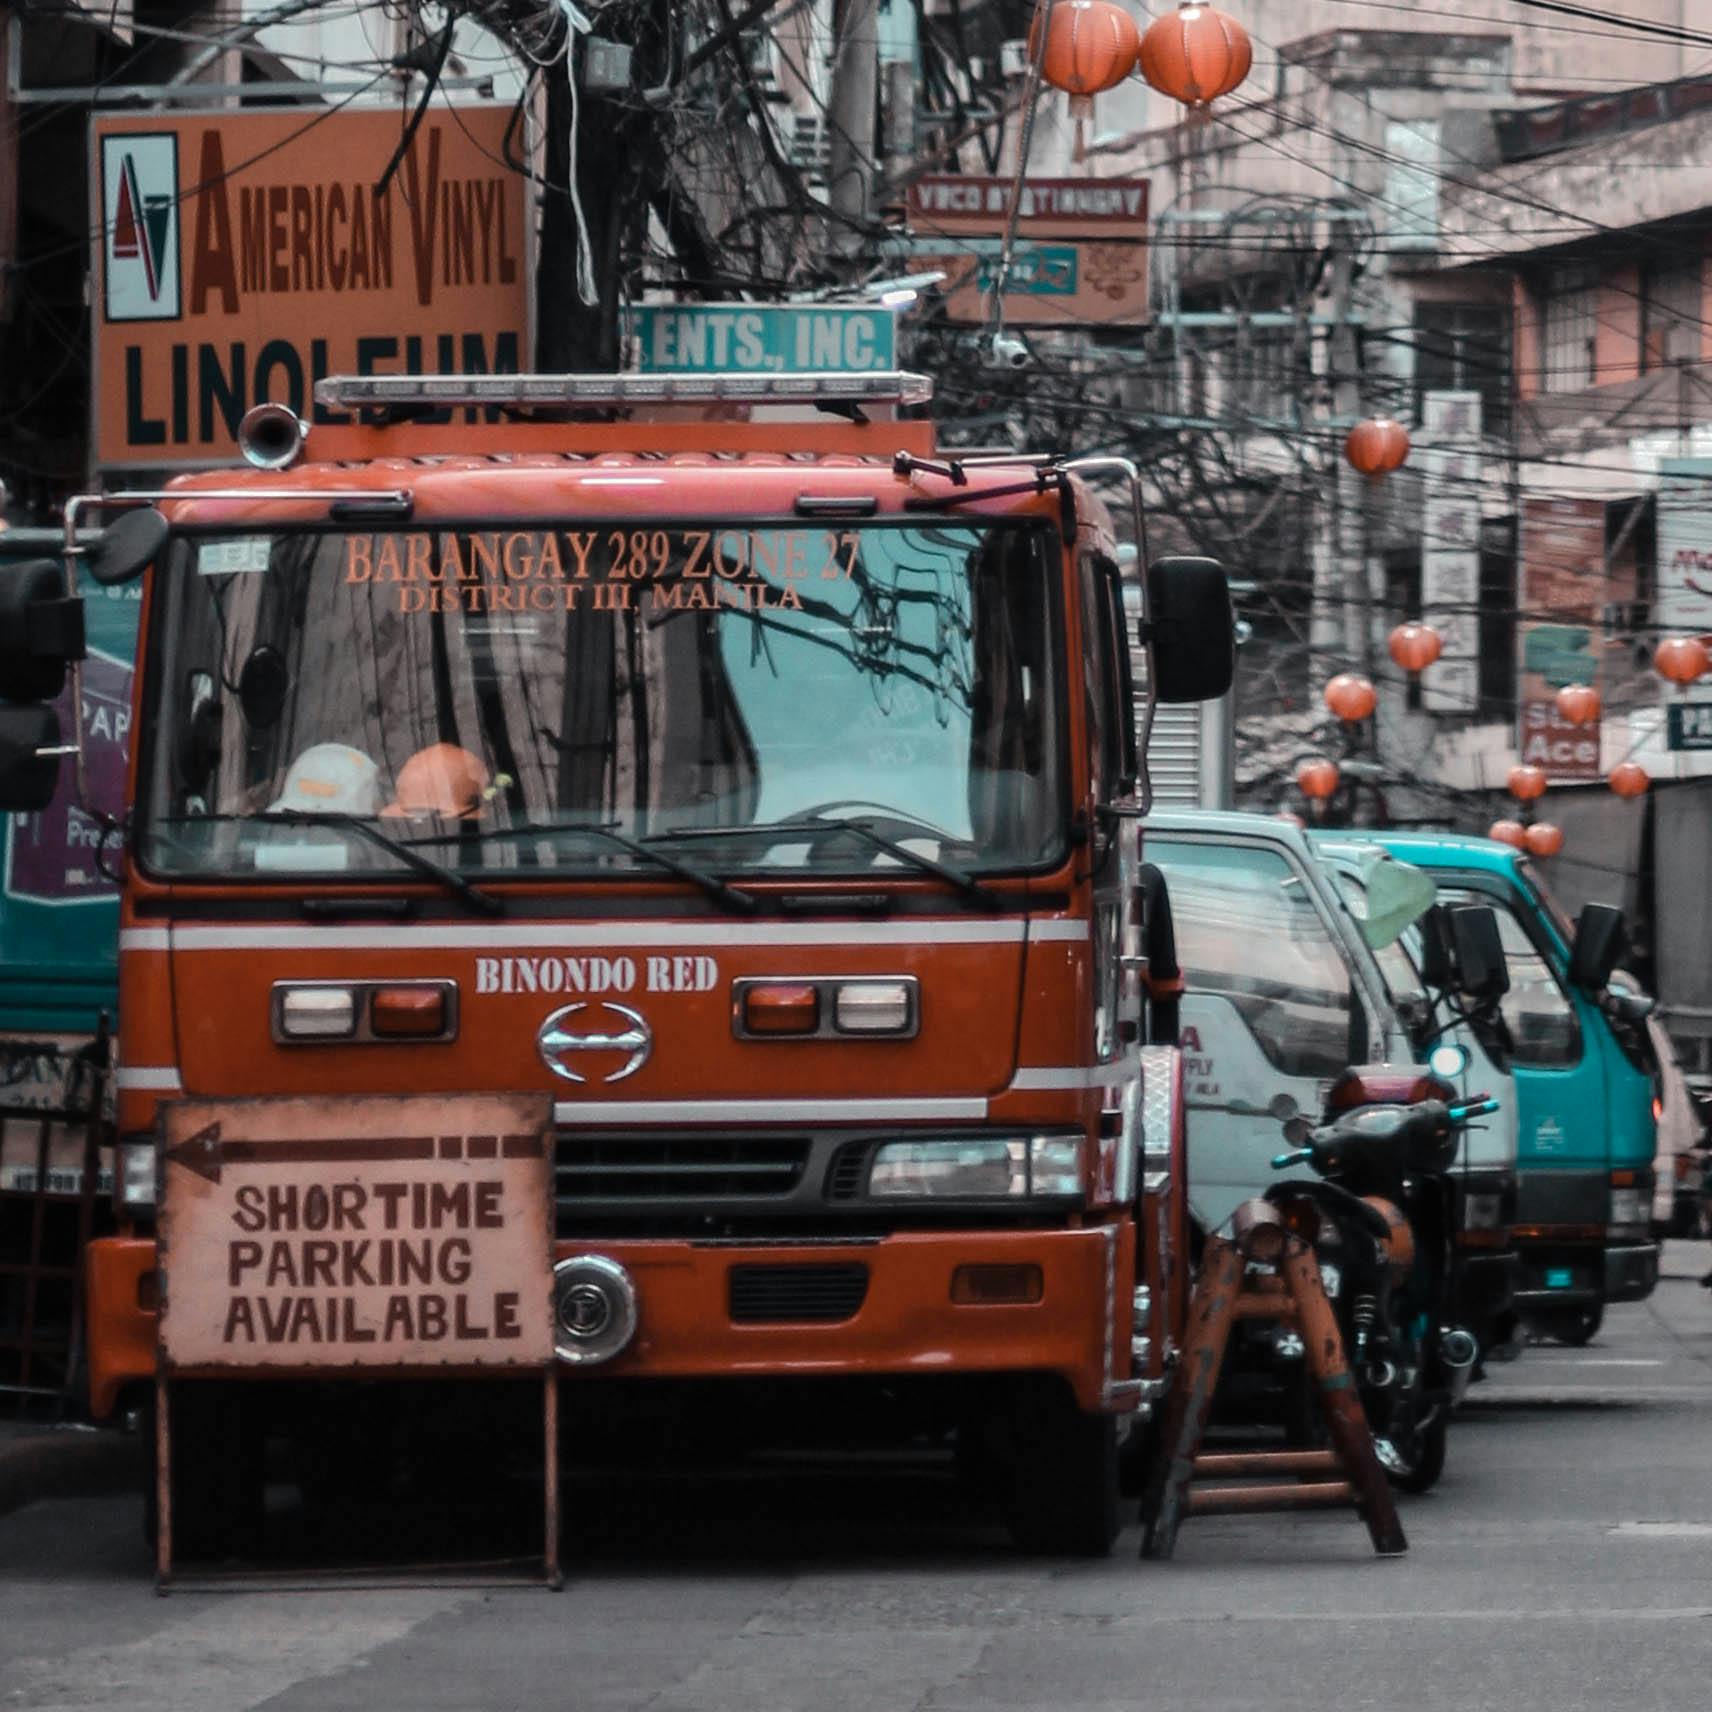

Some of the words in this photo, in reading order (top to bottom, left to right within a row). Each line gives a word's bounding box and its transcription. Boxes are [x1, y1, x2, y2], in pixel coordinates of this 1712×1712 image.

[191, 130, 392, 314] AMERICAN
[403, 127, 517, 306] VINYL
[795, 314, 886, 370] INC.
[346, 531, 597, 584] BARANGAY
[607, 531, 670, 579] 289
[683, 531, 807, 579] ZONE
[824, 531, 860, 579] 27
[400, 583, 582, 613] DISTRICT
[652, 583, 804, 611] MANILA
[475, 956, 635, 994] BINONDO
[646, 956, 718, 992] RED
[228, 1238, 472, 1287] PARKING
[223, 1292, 522, 1344] AVAILABLE
